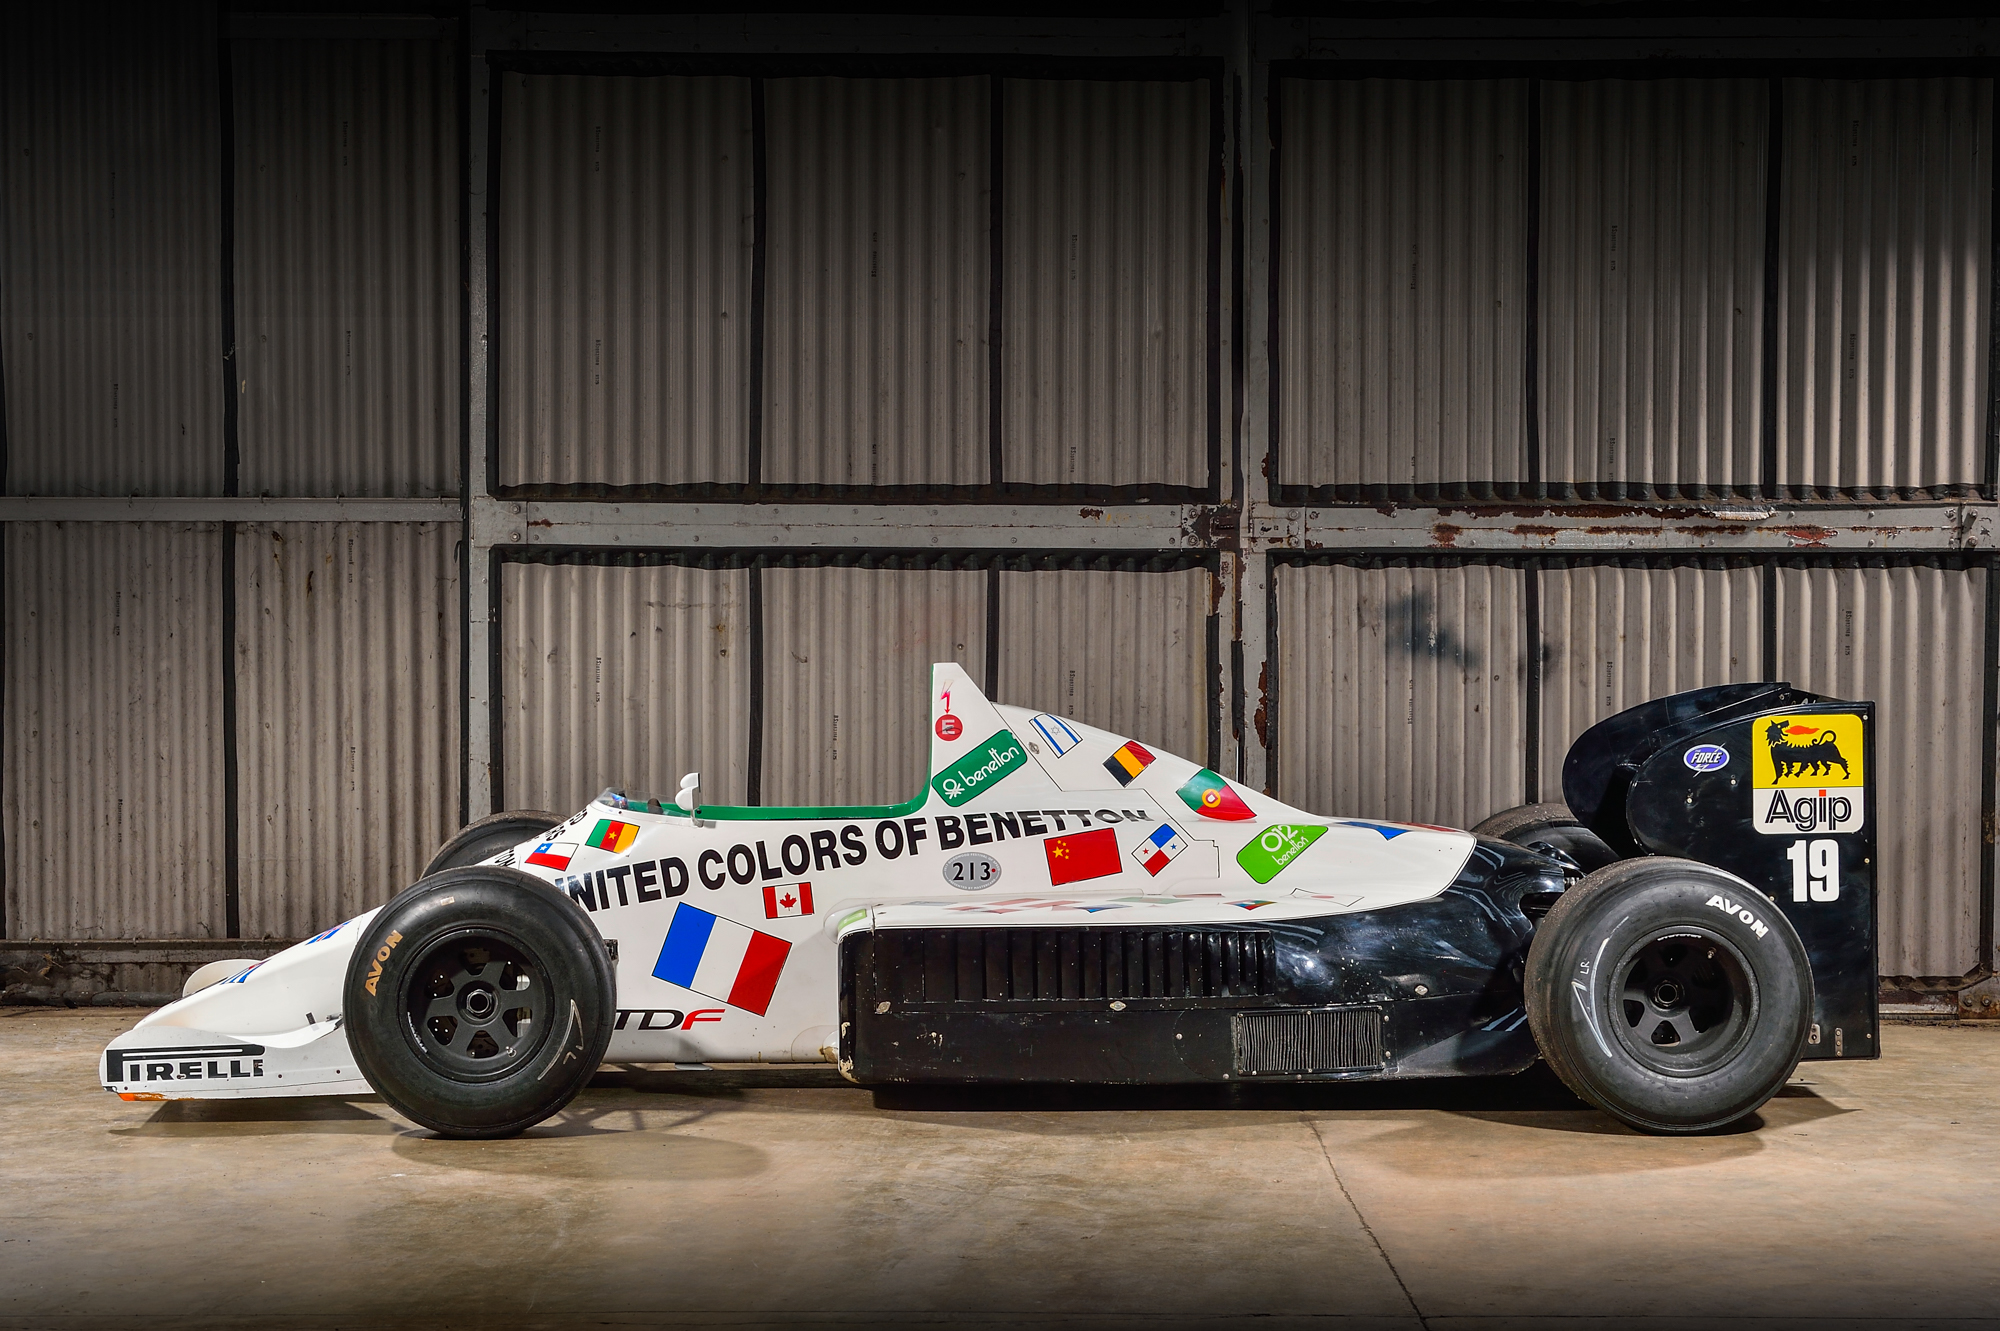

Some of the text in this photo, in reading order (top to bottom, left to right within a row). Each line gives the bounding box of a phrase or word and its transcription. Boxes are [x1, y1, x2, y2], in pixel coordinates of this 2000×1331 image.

[957, 746, 1020, 787] benetton
[1690, 752, 1723, 764] FORCE
[1764, 789, 1852, 832] Agip
[697, 824, 868, 891] COLORS
[874, 817, 928, 860] OF
[934, 809, 1155, 851] BENETTON
[1271, 835, 1310, 866] benetton
[1786, 838, 1840, 903] 19
[952, 861, 991, 881] 213
[1705, 894, 1770, 939] AVON
[364, 929, 404, 997] AVON
[613, 1008, 726, 1031] TDF
[106, 1043, 266, 1083] PIRELLI
